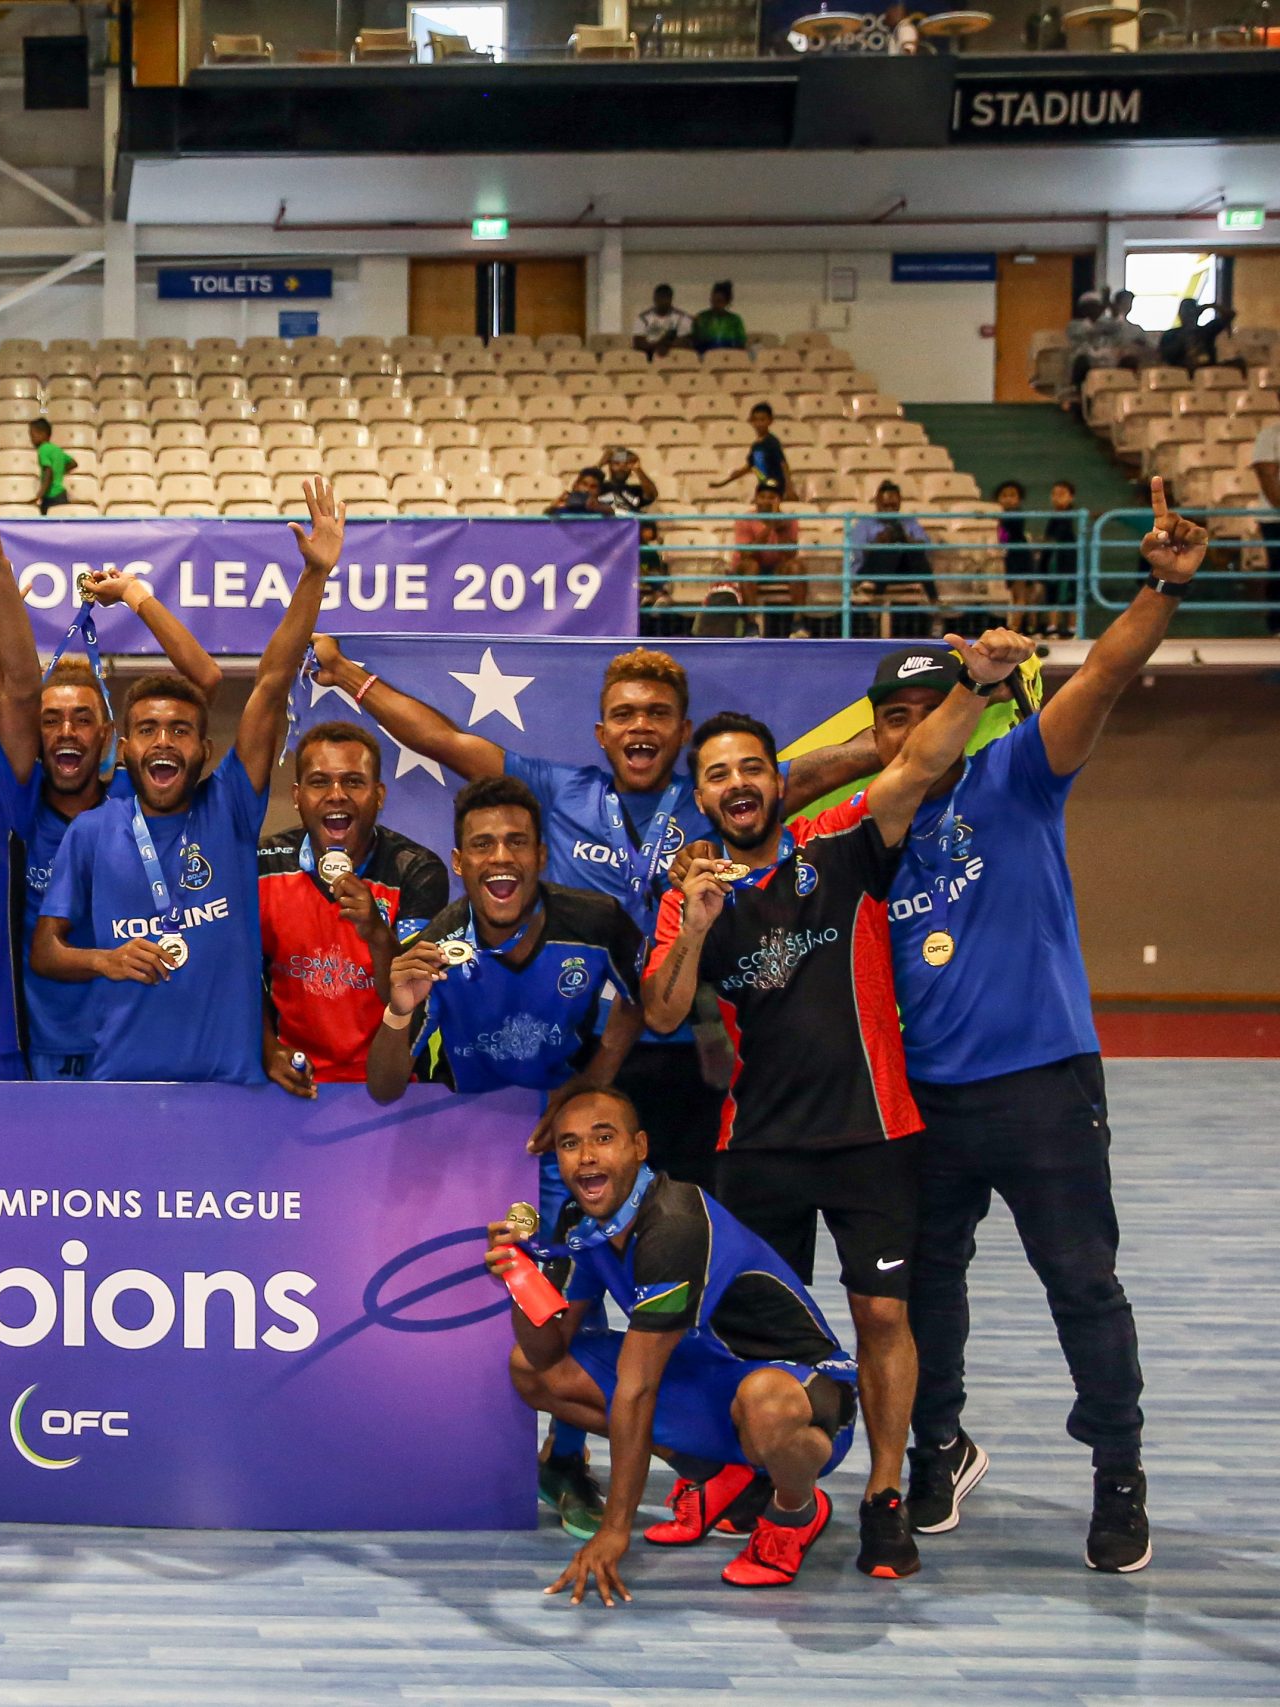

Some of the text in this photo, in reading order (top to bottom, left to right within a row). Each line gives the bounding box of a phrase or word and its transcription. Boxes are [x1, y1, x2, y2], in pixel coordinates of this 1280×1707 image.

[970, 88, 1142, 127] STADIUM
[190, 274, 273, 293] TOILETS
[453, 562, 603, 612] 2019
[903, 656, 934, 670] NIKE
[323, 864, 349, 873] OFC
[111, 897, 229, 938] KOOINE
[927, 944, 949, 954] OFC
[157, 1190, 301, 1220] LEAGUE
[41, 1410, 129, 1436] OFC
